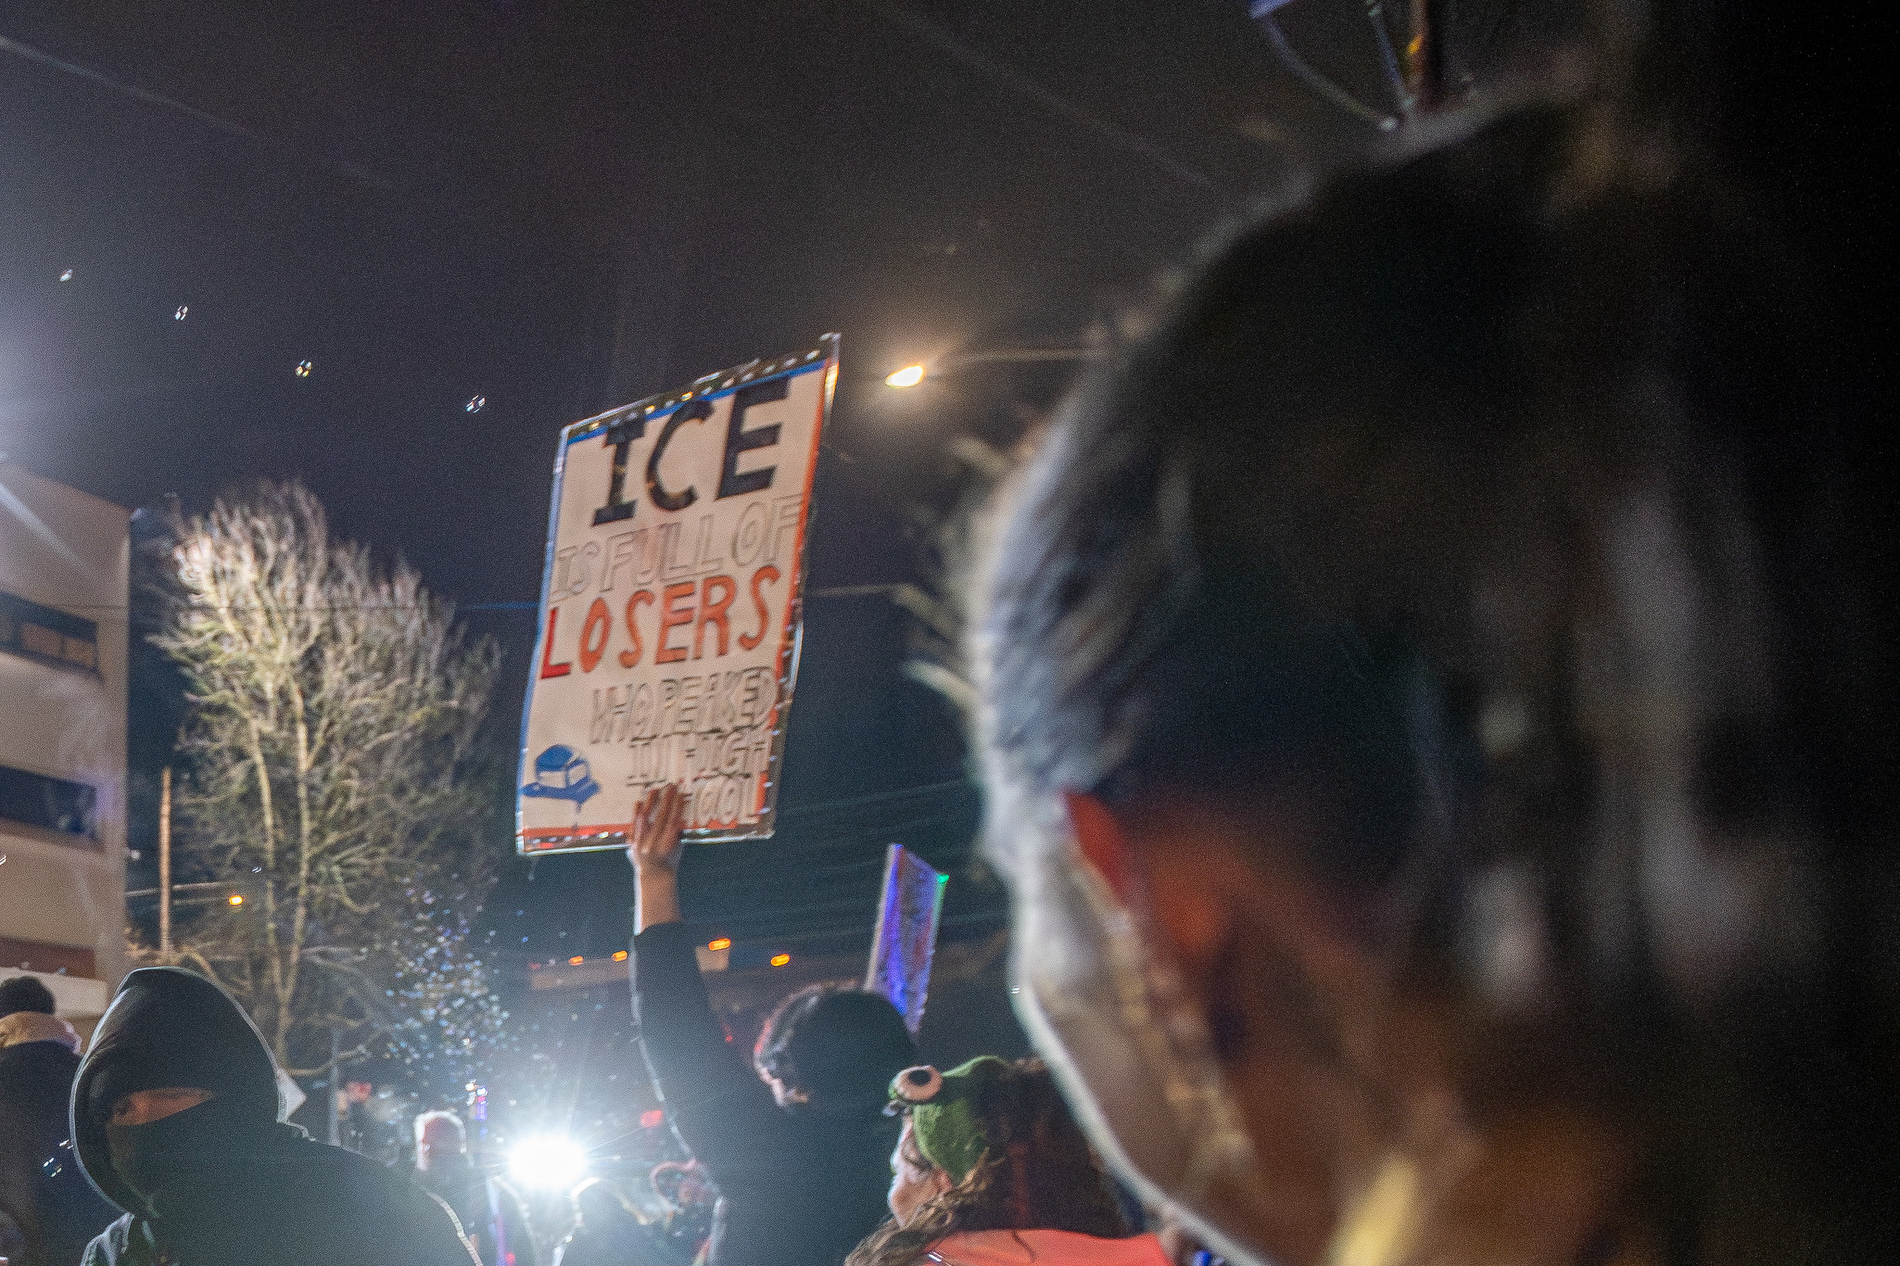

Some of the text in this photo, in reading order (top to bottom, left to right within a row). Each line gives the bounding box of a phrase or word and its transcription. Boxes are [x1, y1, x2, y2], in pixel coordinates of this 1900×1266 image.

[592, 375, 791, 527] ICE
[600, 520, 723, 594] FULL
[731, 493, 803, 568] OF
[540, 565, 781, 679] LOSERS
